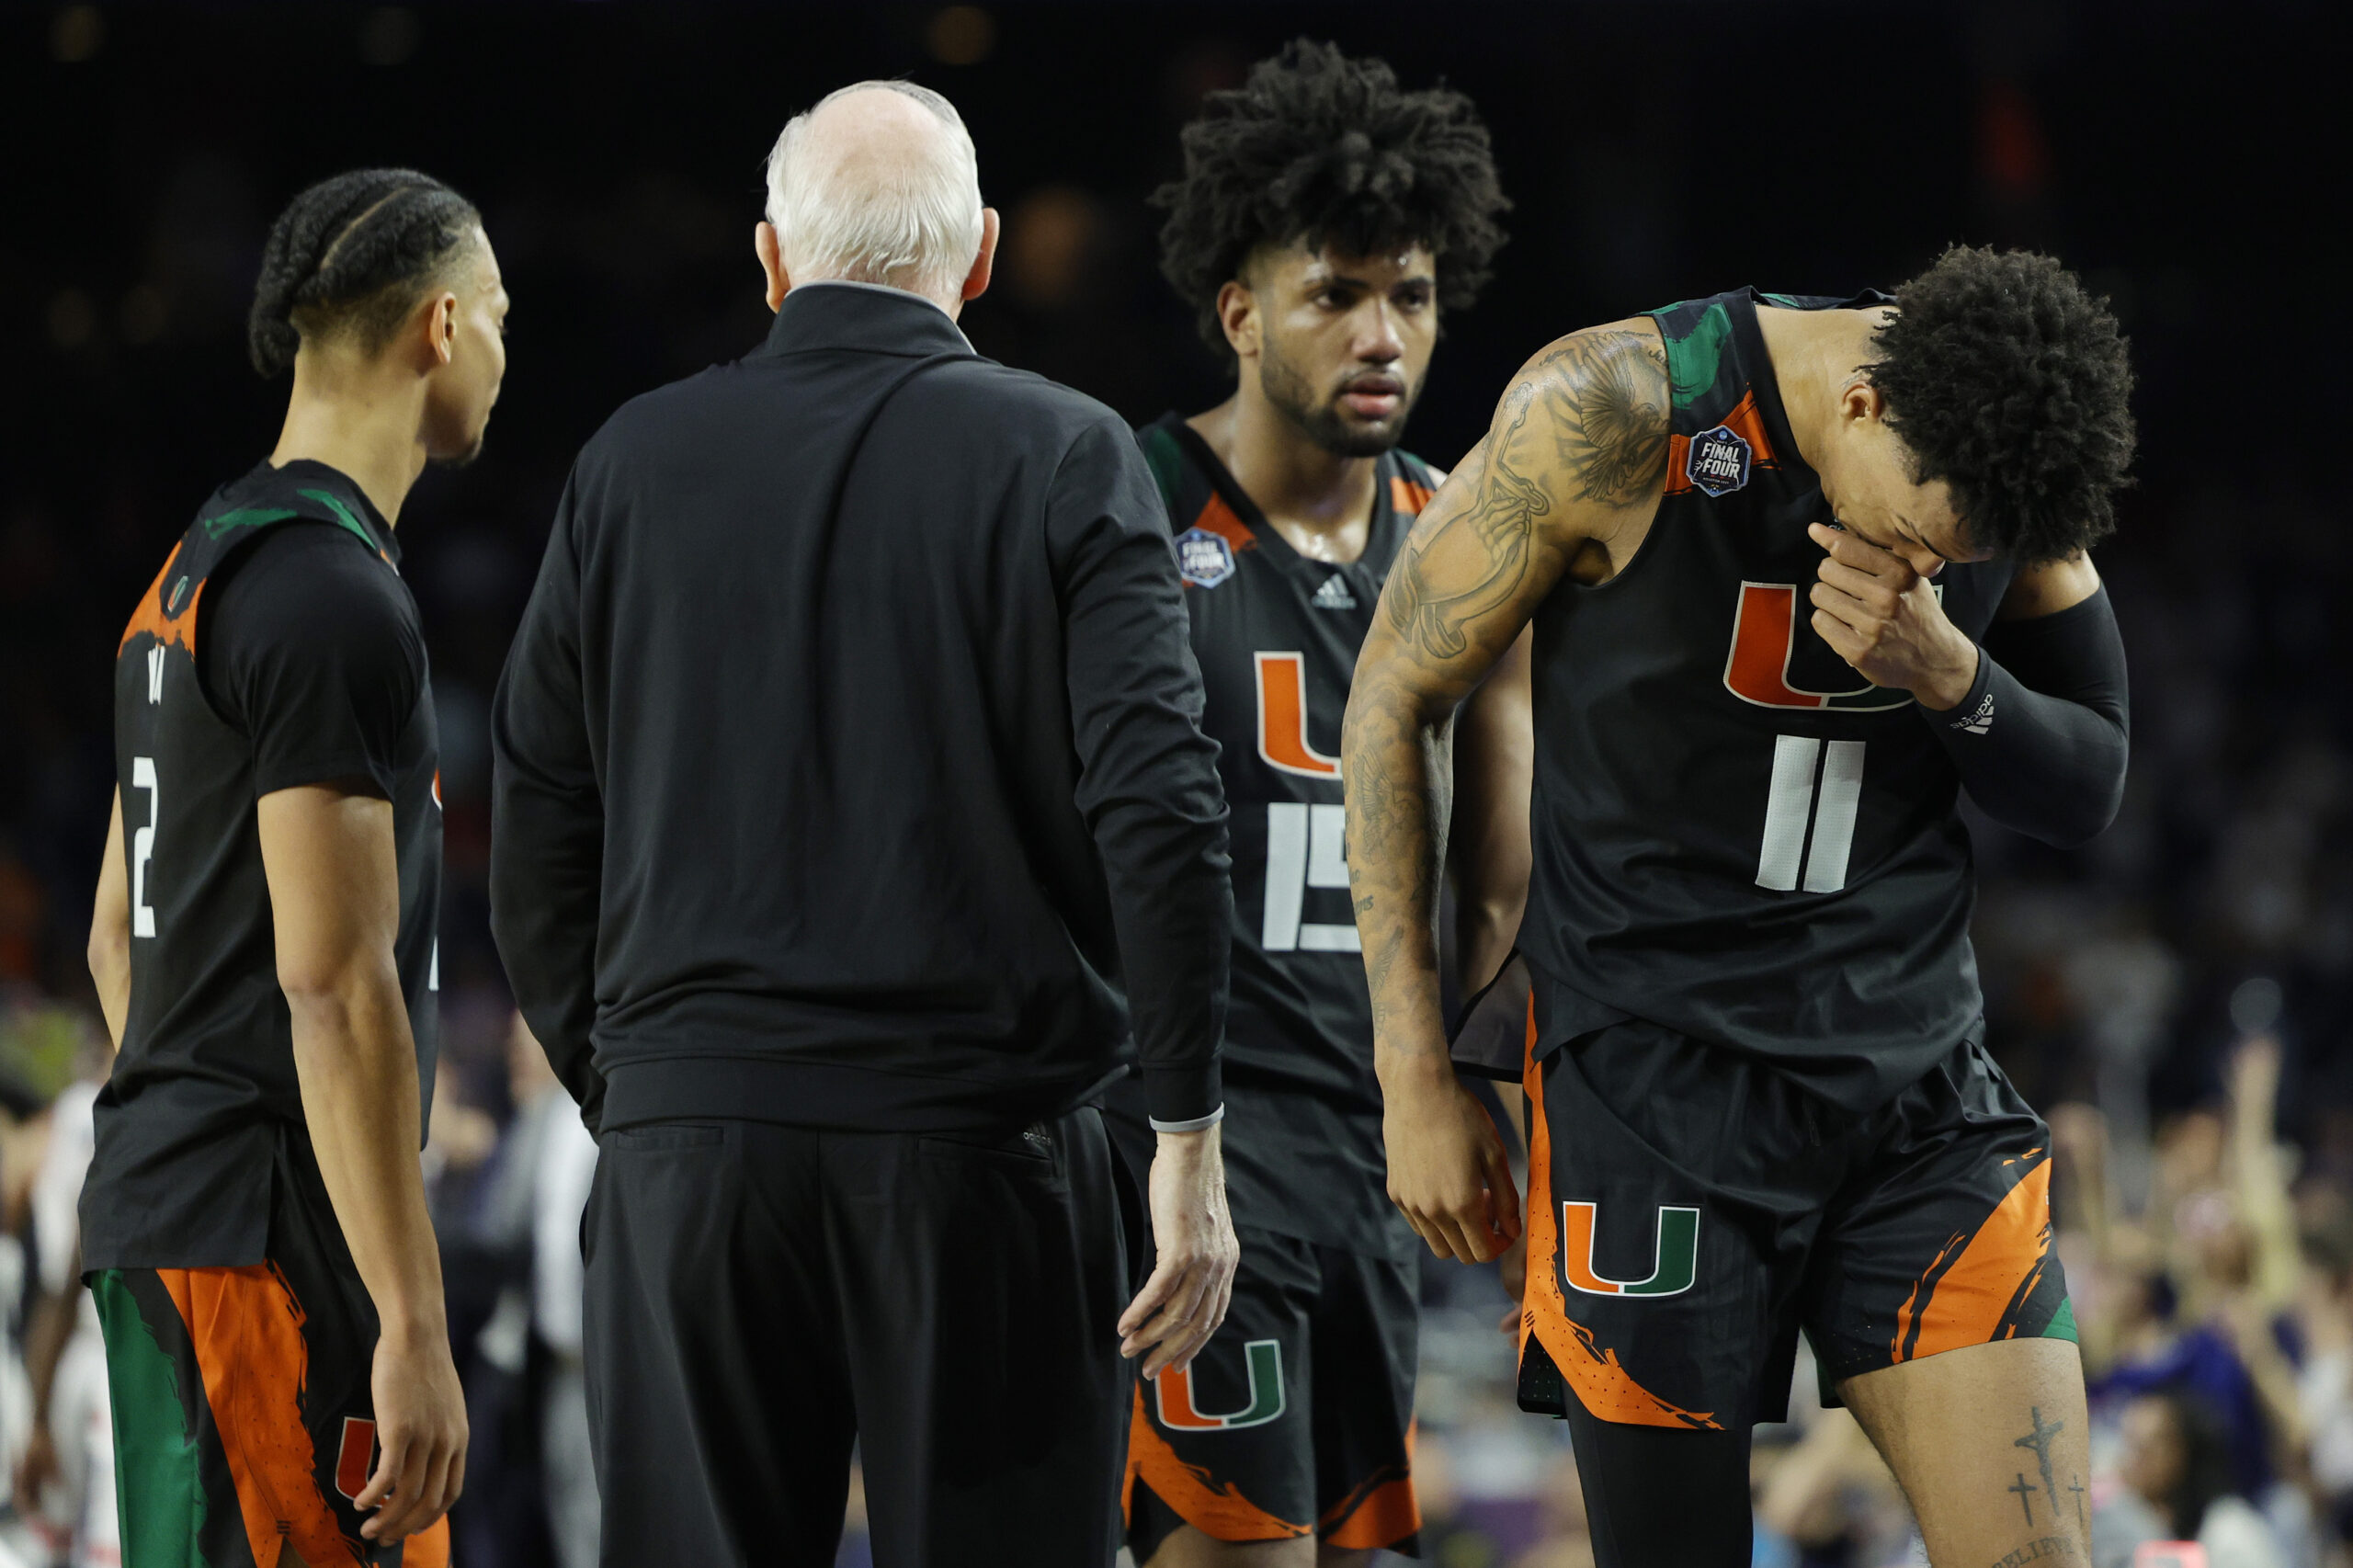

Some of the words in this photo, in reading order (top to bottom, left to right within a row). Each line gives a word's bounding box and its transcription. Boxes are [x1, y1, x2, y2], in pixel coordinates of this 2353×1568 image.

[1701, 442, 1740, 462] FINAL
[1702, 459, 1741, 478] FOUR
[1949, 694, 1993, 728] adidas
[1755, 733, 1867, 893] 11
[132, 756, 158, 937] 2
[1563, 1200, 1700, 1297] U
